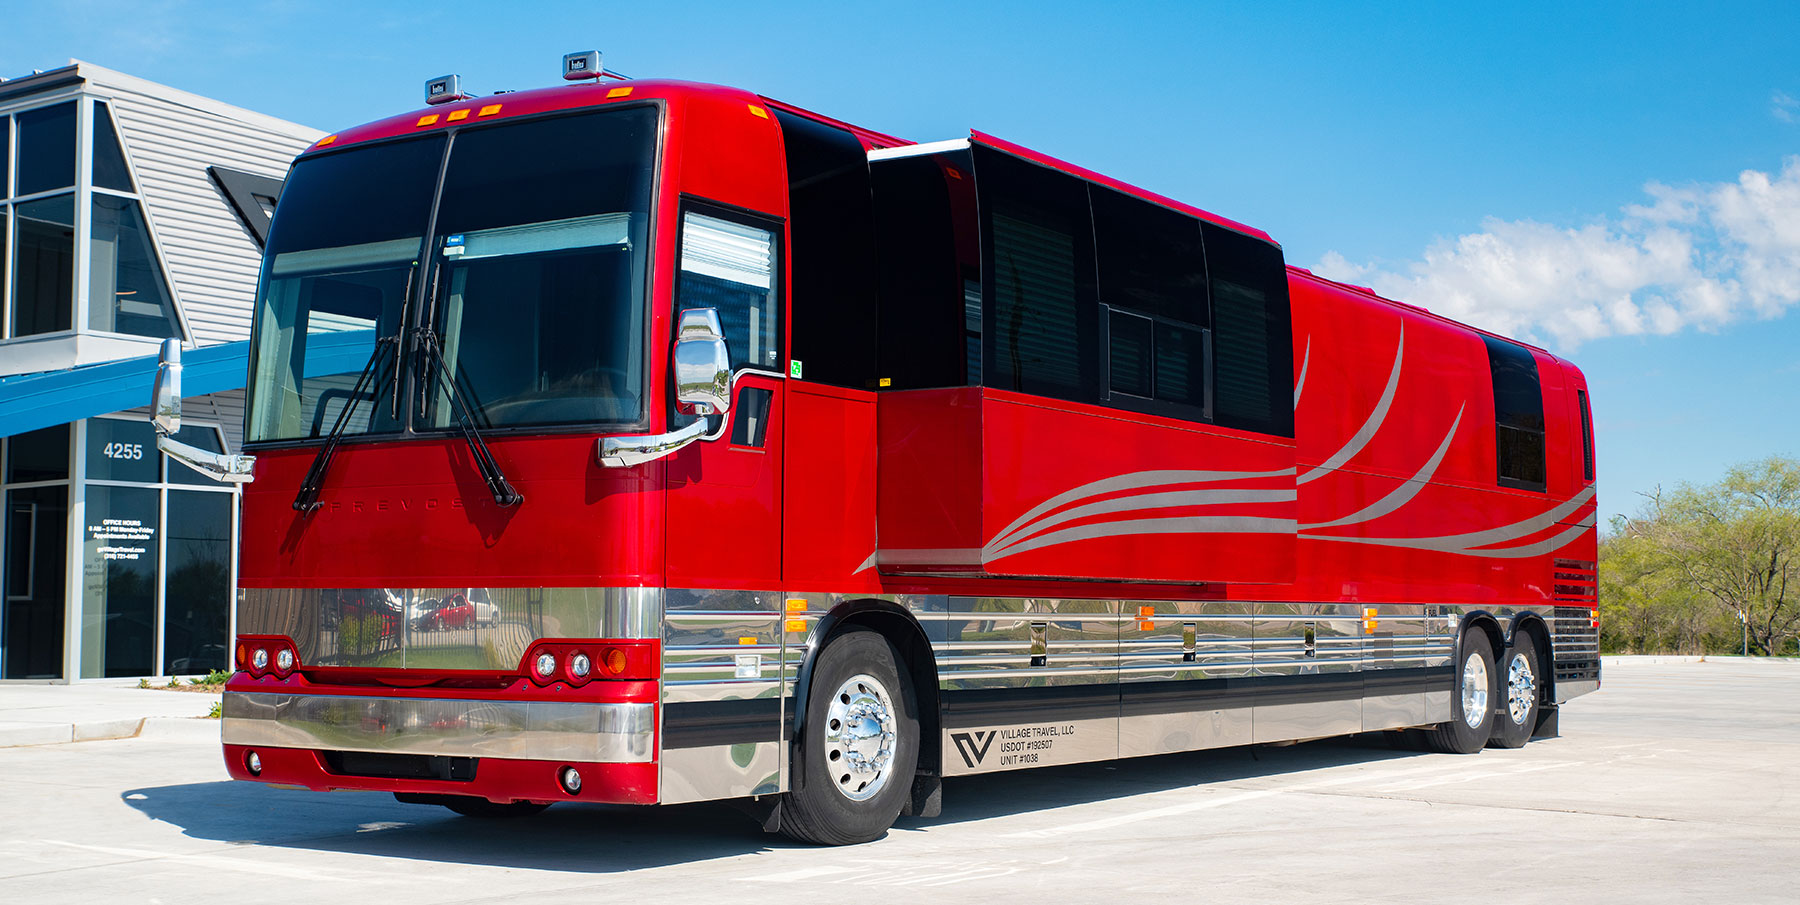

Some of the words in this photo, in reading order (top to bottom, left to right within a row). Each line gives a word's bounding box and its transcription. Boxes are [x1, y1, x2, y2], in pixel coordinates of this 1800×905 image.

[103, 442, 143, 460] 4255
[1001, 728, 1031, 739] VILLAGE
[1032, 726, 1060, 737] TRAVEL,
[1062, 725, 1075, 735] LLC
[1001, 741, 1026, 752] USDOT
[1026, 740, 1053, 751] #192507
[1001, 754, 1018, 765] UNIT
[1019, 753, 1039, 764] #1038
